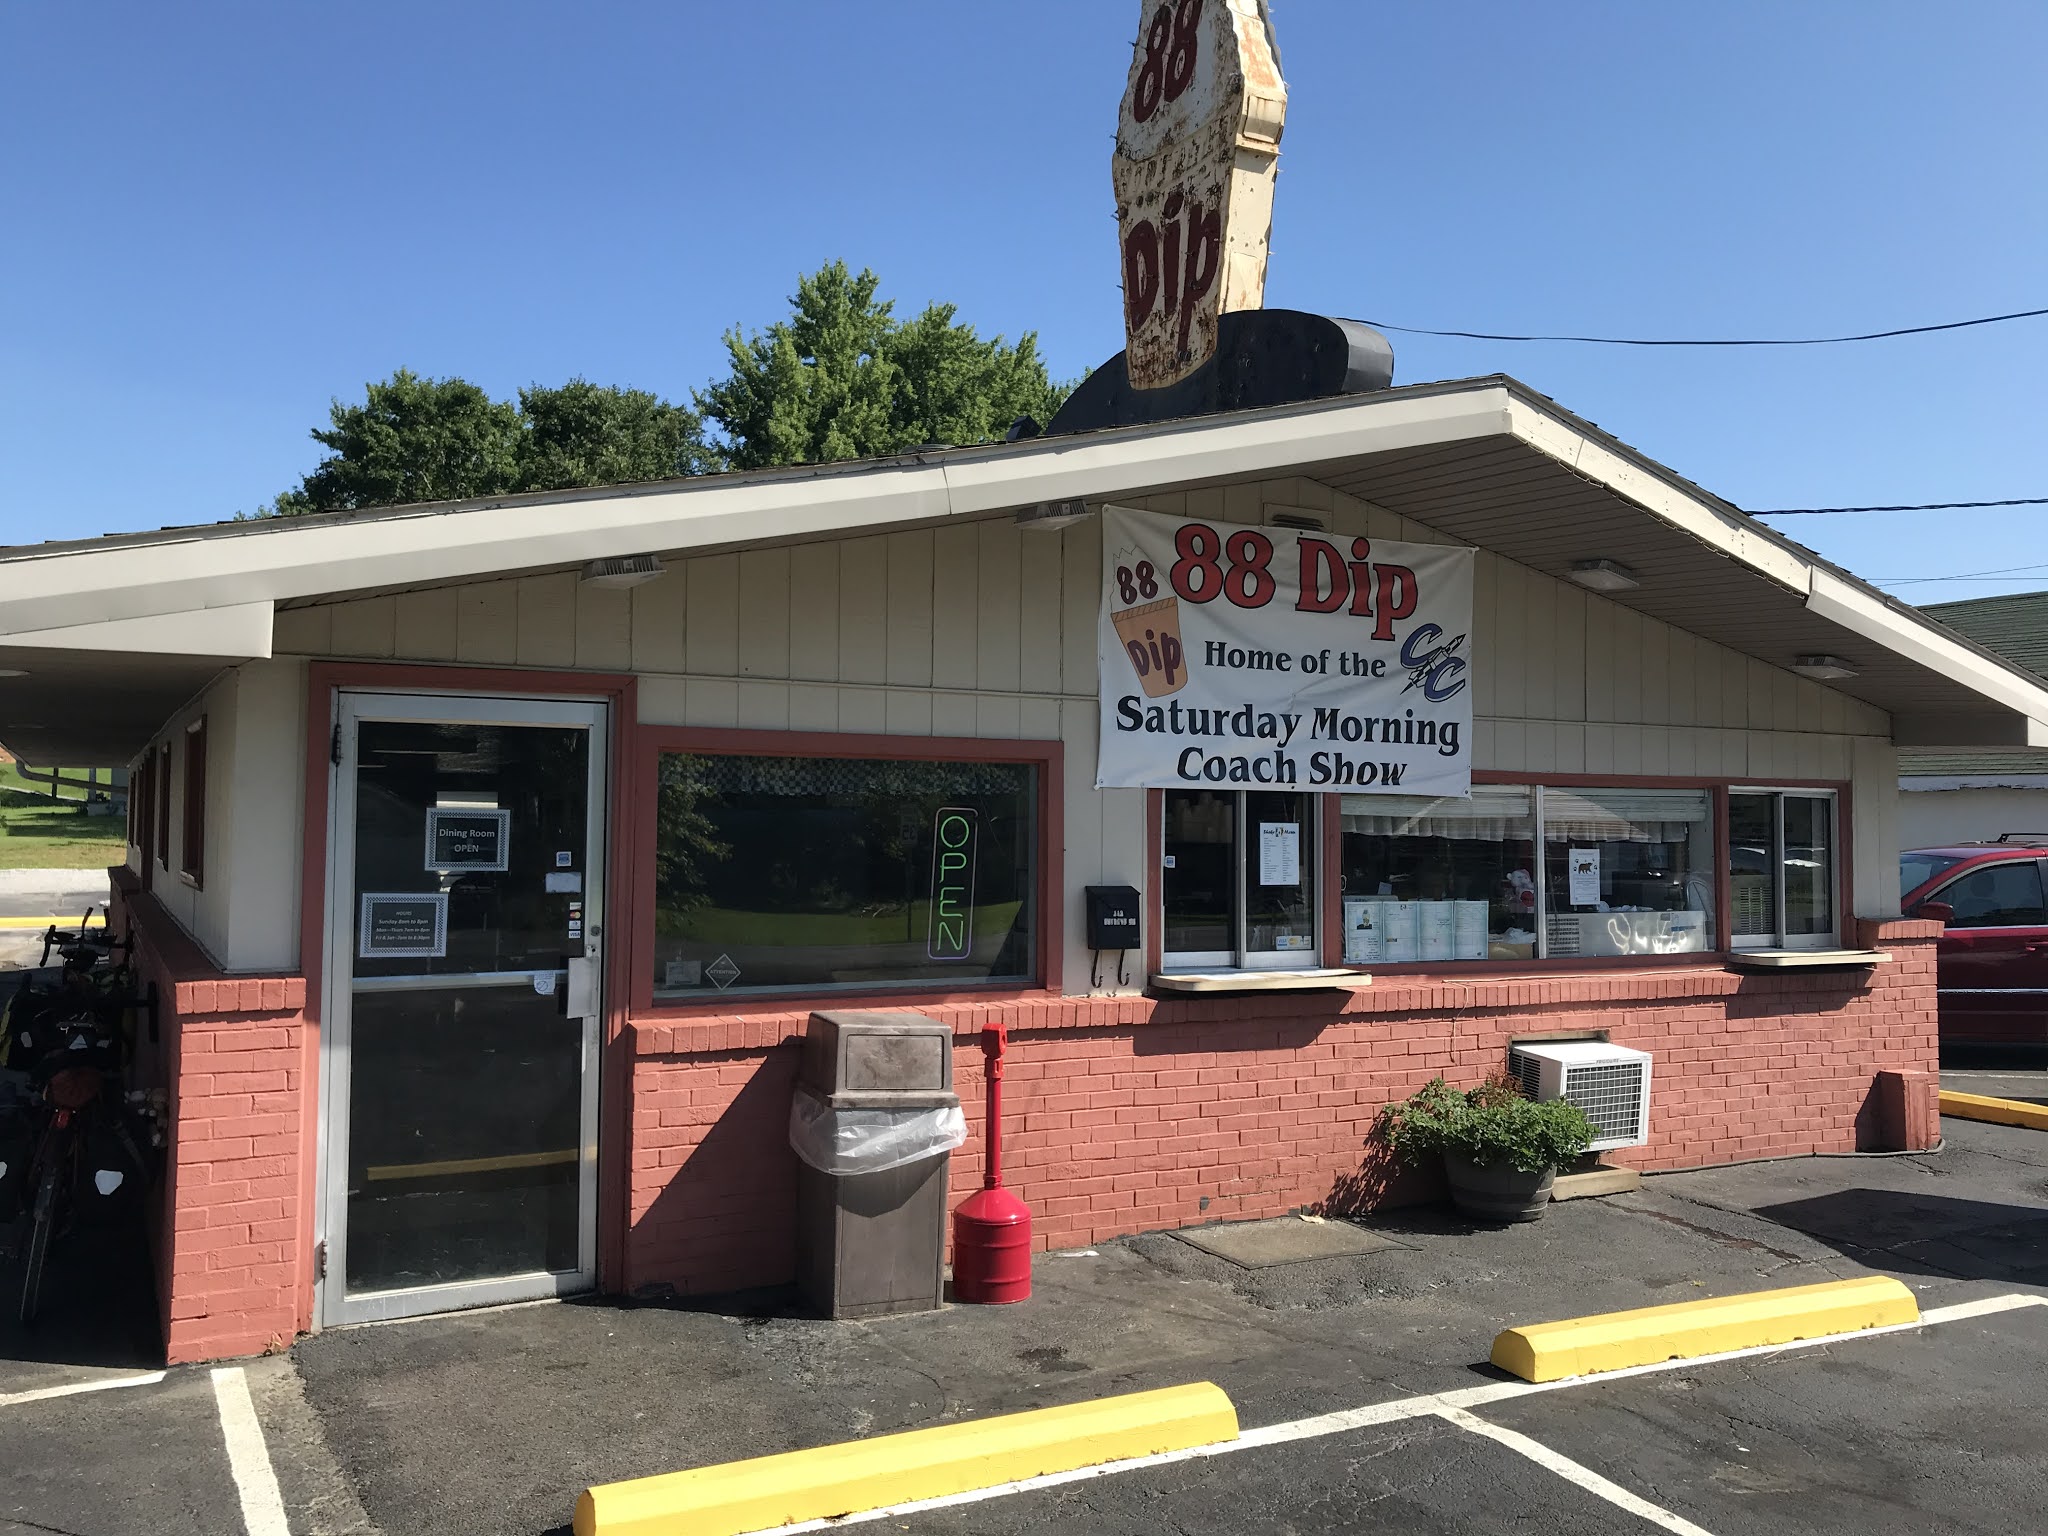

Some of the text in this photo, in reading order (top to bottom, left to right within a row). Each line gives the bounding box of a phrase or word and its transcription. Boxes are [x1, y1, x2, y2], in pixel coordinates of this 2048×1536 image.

[1133, 0, 1200, 123] 88
[1116, 560, 1158, 605] 88
[1170, 523, 1418, 641] 88 Dip
[1127, 629, 1181, 686] Dip
[1204, 640, 1386, 678] Home of the
[1116, 695, 1460, 757] Saturday Morning
[1177, 747, 1408, 786] Coach Show
[439, 828, 495, 838] Dining Room
[454, 844, 479, 853] OPEN
[937, 815, 970, 952] OPEN
